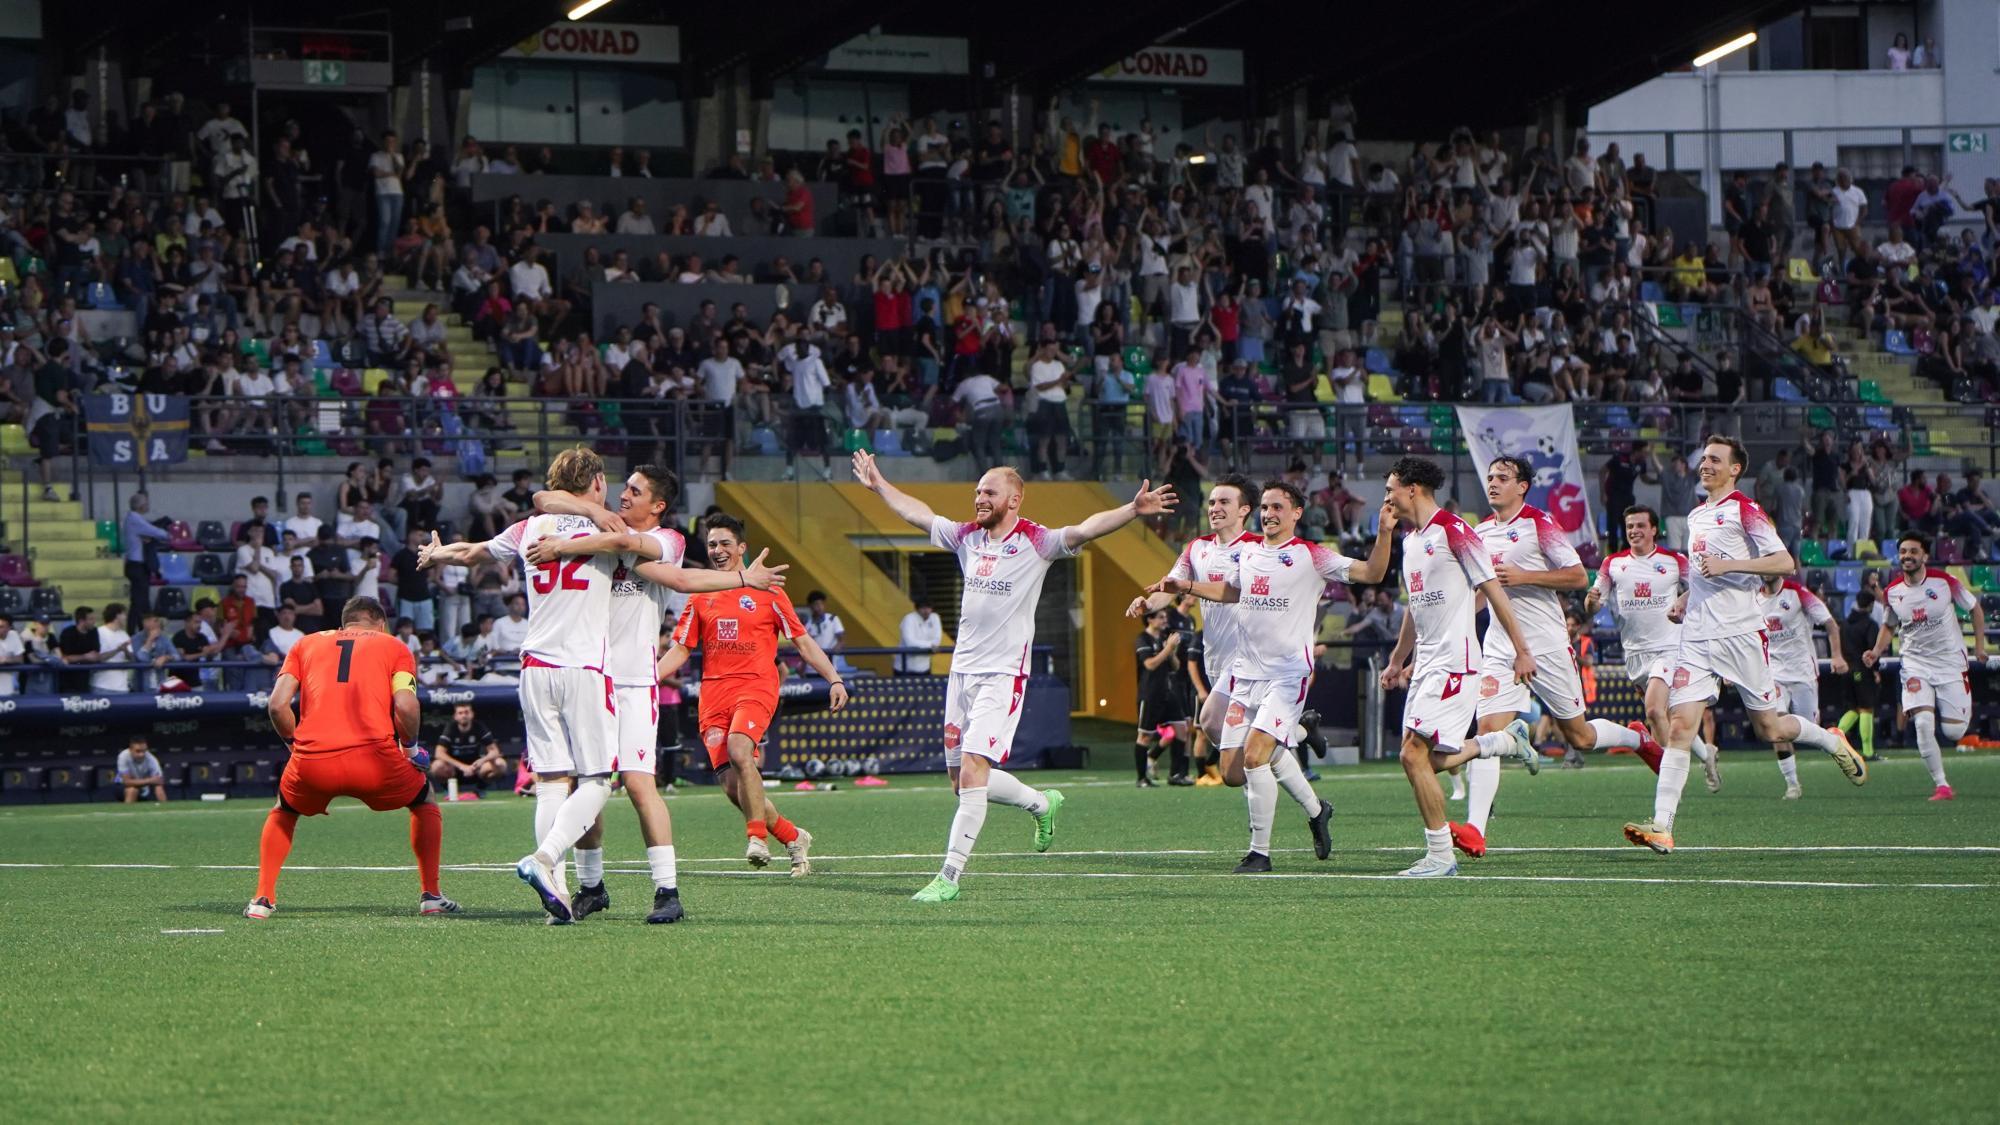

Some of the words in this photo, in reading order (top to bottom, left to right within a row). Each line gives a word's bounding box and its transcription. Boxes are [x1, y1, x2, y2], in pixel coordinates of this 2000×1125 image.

[542, 28, 640, 55] CONAD
[1121, 52, 1208, 77] CONAD
[611, 581, 644, 593] KASSE
[965, 577, 1013, 592] PARKASSE
[1241, 596, 1290, 608] PARKASSE
[1410, 590, 1445, 603] RKASSE
[336, 639, 355, 683] 1
